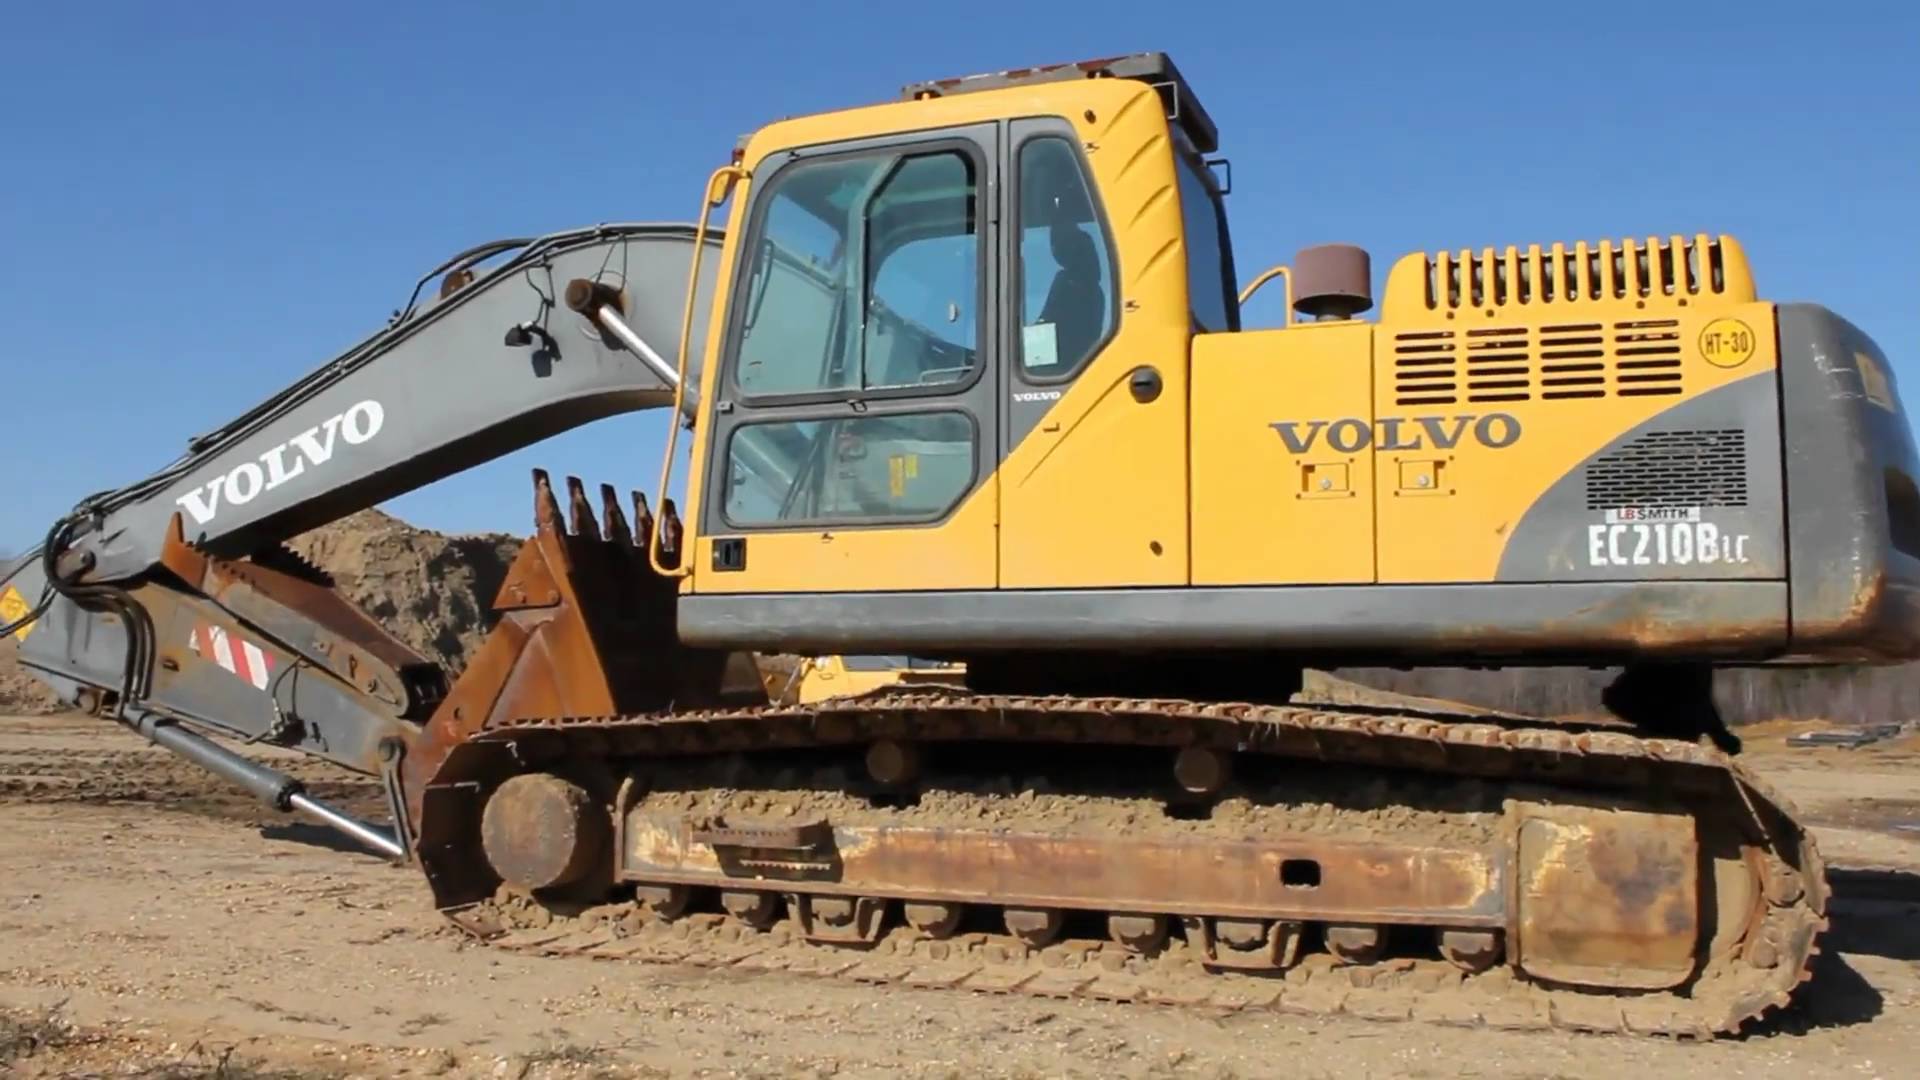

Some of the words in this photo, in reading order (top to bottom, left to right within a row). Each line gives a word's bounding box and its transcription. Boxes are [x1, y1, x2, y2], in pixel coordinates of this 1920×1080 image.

[1705, 331, 1748, 354] HT-30
[1012, 391, 1061, 402] VOLVO
[1268, 413, 1522, 454] VOLVO
[175, 399, 384, 525] VOLVO
